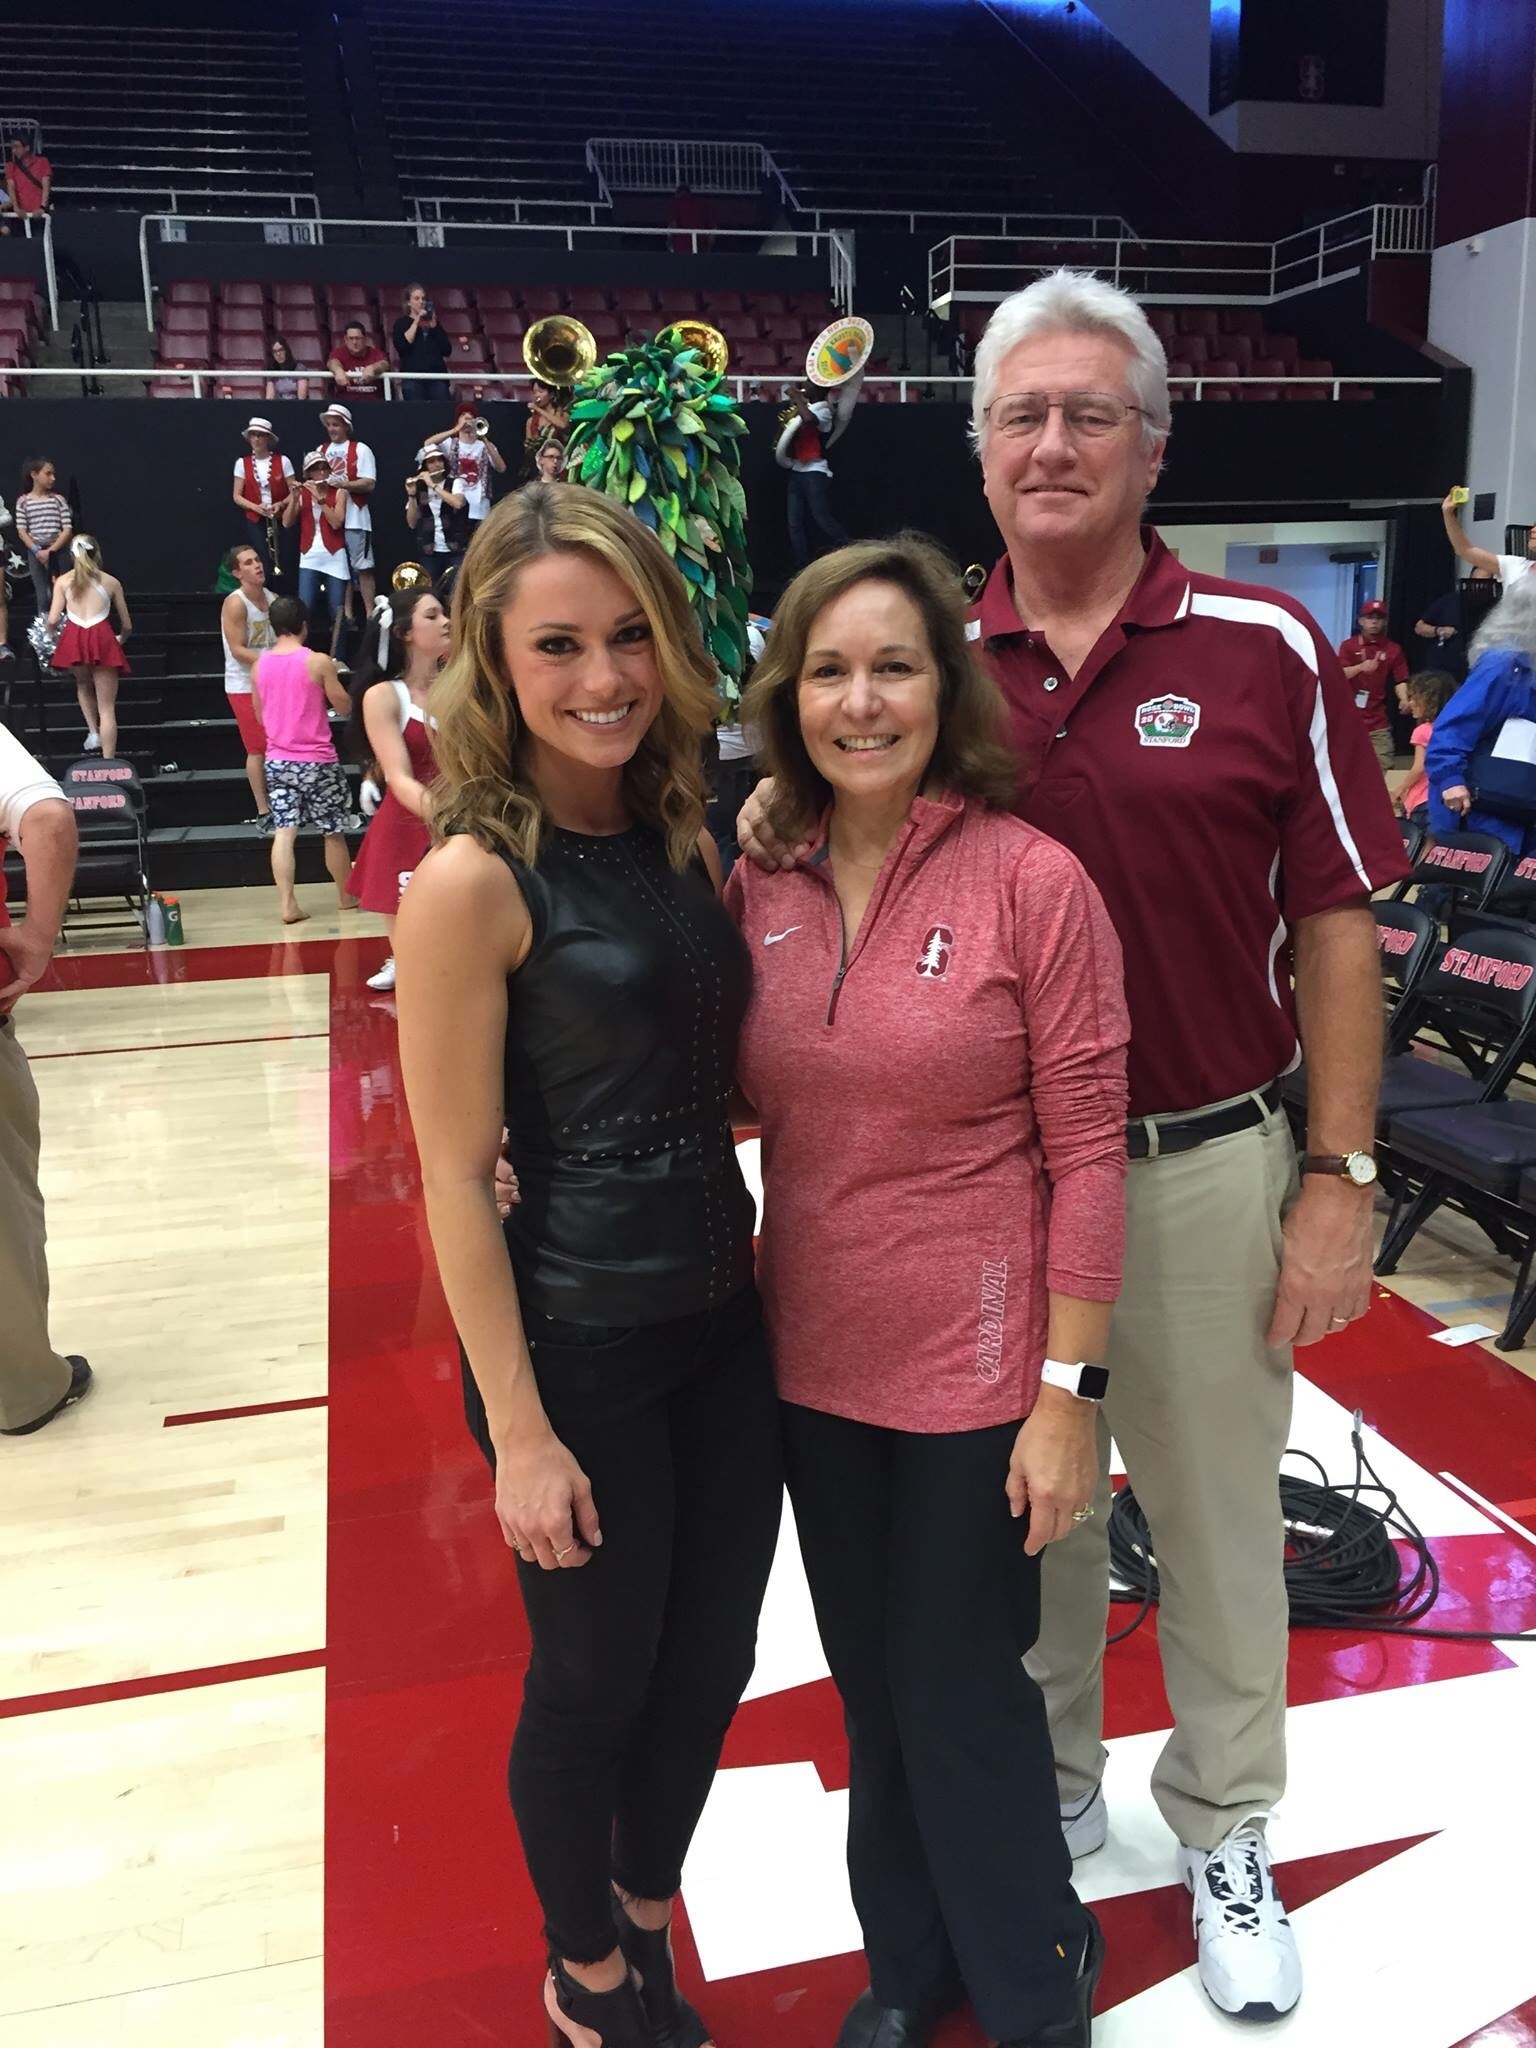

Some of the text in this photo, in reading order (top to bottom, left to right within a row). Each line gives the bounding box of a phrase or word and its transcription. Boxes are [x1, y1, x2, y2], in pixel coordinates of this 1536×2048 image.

[72, 768, 133, 782] STANFORD
[68, 795, 126, 810] TANFORD
[1424, 846, 1492, 873] STANFORD
[1376, 924, 1417, 955] FORD
[1439, 948, 1534, 991] STANFORD
[975, 1260, 1008, 1384] CARDINAL
